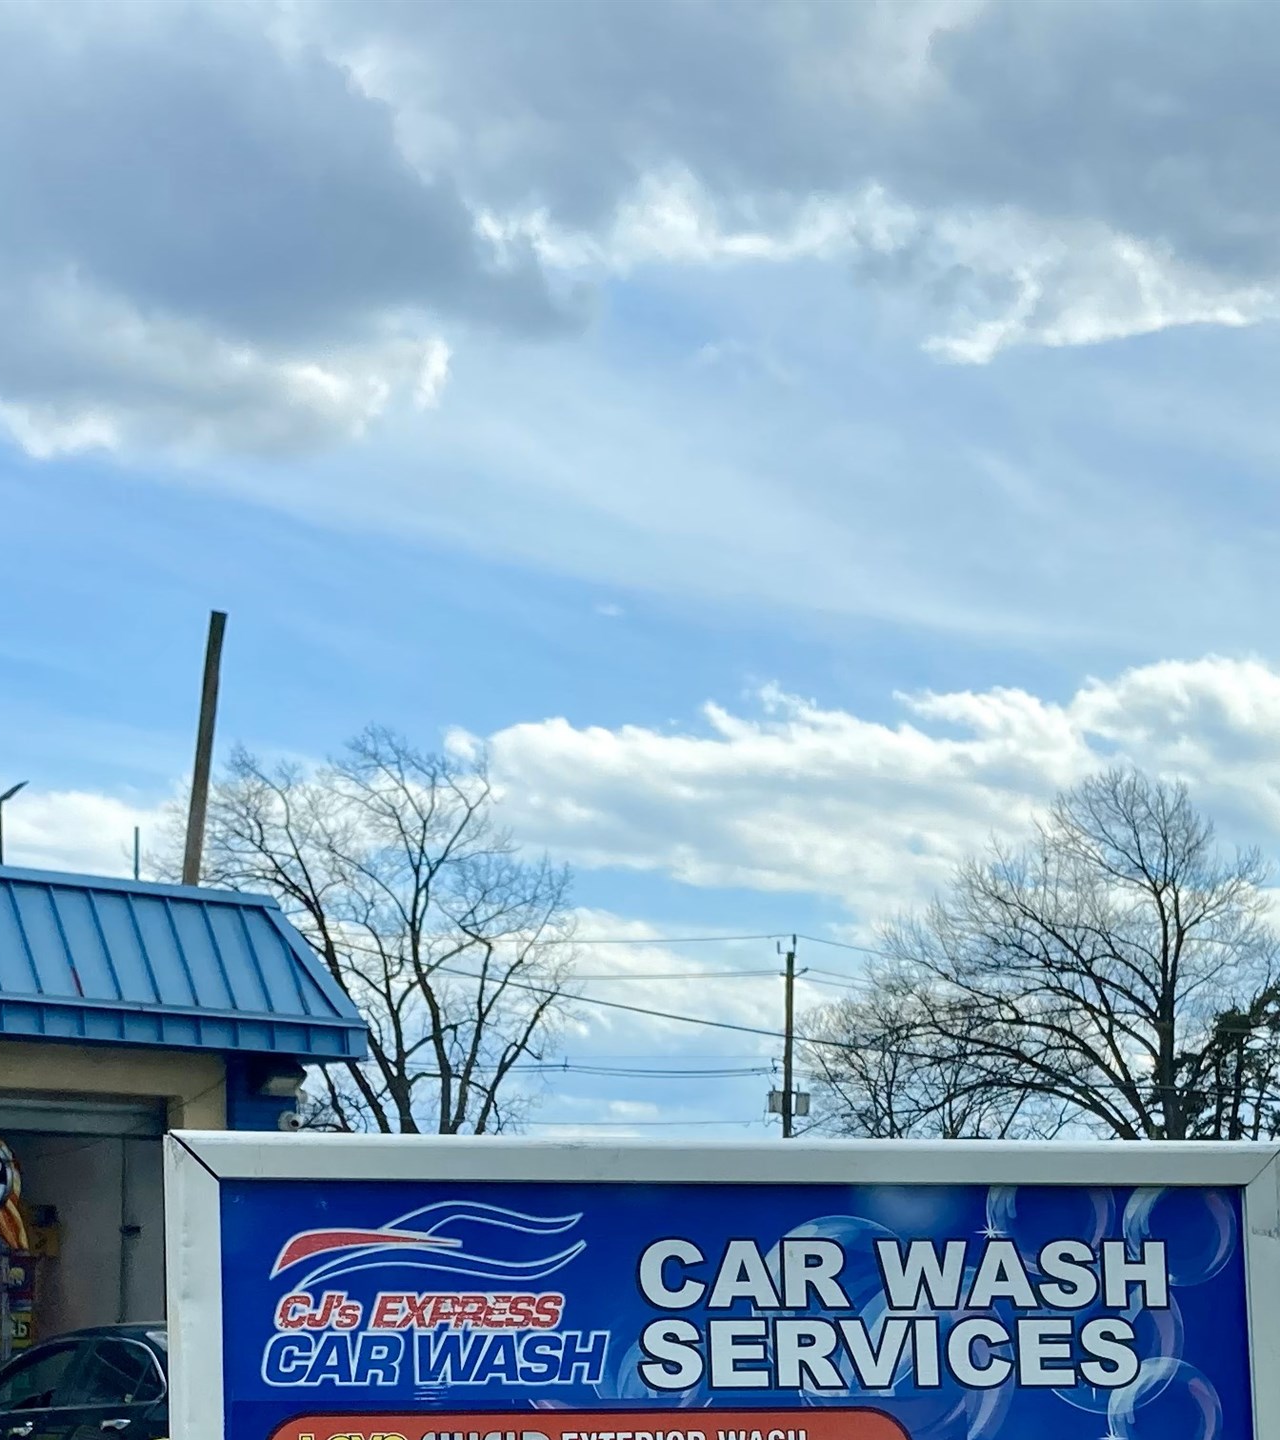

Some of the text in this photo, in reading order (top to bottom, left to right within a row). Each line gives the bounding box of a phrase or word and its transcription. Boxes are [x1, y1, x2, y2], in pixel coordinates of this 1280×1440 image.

[638, 1238, 1169, 1309] CAR WASH
[276, 1291, 565, 1330] CJ's EXPRESS
[262, 1331, 607, 1386] CAR WASH
[639, 1317, 1141, 1390] SERVICES
